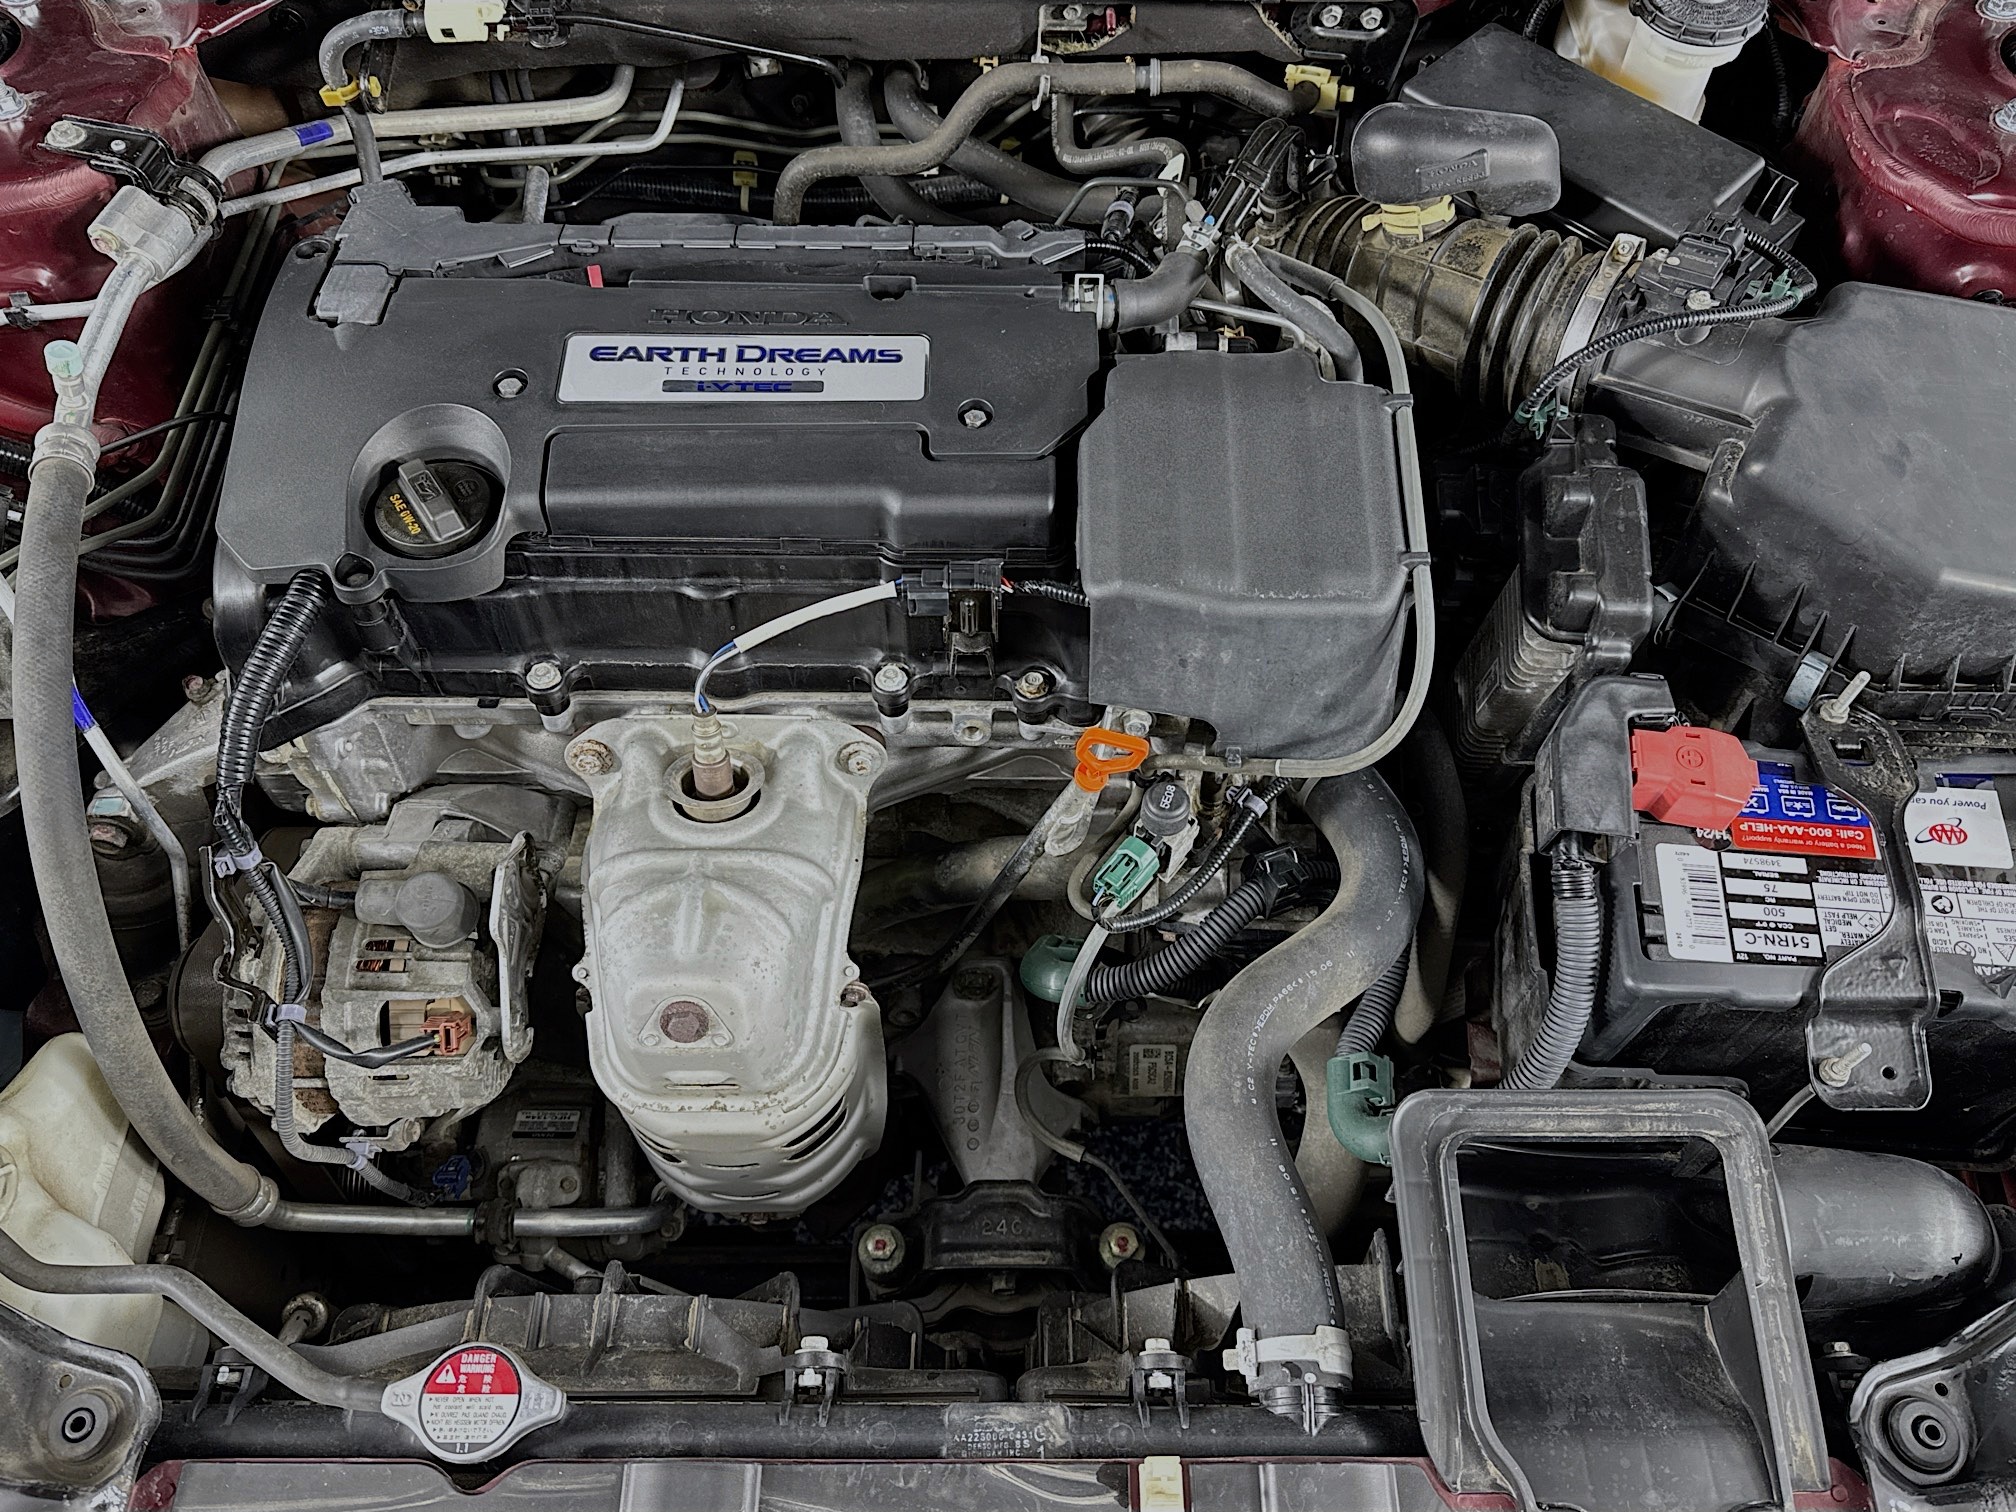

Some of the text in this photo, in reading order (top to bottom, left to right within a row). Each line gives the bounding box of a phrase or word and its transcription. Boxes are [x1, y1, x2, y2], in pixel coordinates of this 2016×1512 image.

[647, 309, 850, 325] HONDA
[589, 345, 903, 363] EARTH DREAMS
[664, 367, 826, 375] TECHNOLOGY
[697, 382, 792, 391] i-VTEC
[390, 493, 421, 534] SAE 0W-20
[1930, 798, 1949, 807] you
[1953, 799, 1986, 810] Power
[1739, 822, 1864, 840] Call: 800-AAA-HELP
[1929, 824, 1967, 844] AAA
[1742, 834, 1772, 843] support?
[1774, 836, 1804, 846] warranty
[1813, 838, 1839, 849] battery
[1847, 842, 1866, 851] Need
[1743, 857, 1782, 867] 3498574
[1763, 884, 1778, 893] 75
[1763, 907, 1785, 917] 500
[1823, 918, 1852, 926] MEDICAL
[1744, 932, 1810, 949] 51RN-C
[1780, 954, 1797, 962] PART
[1248, 1077, 1255, 1090] C2
[461, 1354, 497, 1363] DANGER
[460, 1364, 496, 1374] WARNUNG
[456, 1443, 468, 1453] 1.1
